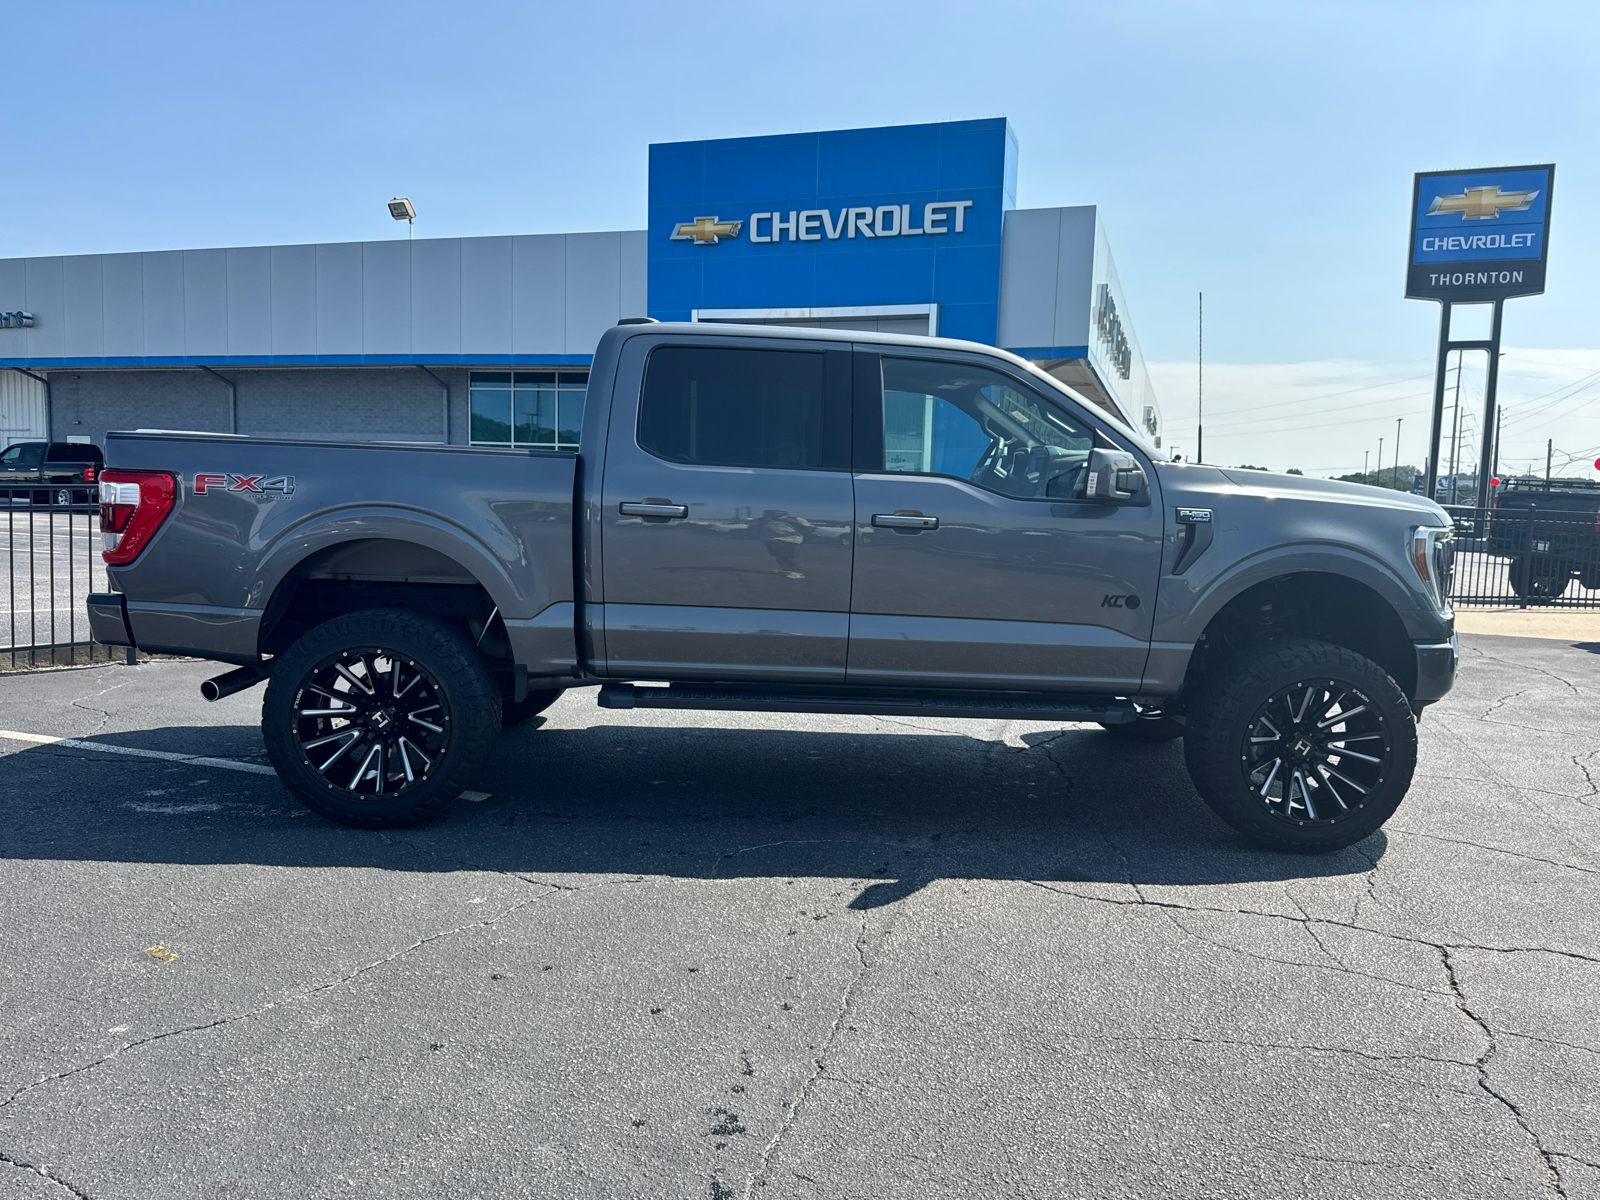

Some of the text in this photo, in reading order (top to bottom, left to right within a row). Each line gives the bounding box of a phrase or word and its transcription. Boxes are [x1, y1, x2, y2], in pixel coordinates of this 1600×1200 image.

[750, 200, 973, 243] CHEVROLET
[1422, 233, 1536, 251] CHEVROLET
[1429, 271, 1523, 286] THORNTON
[193, 472, 296, 496] FX4
